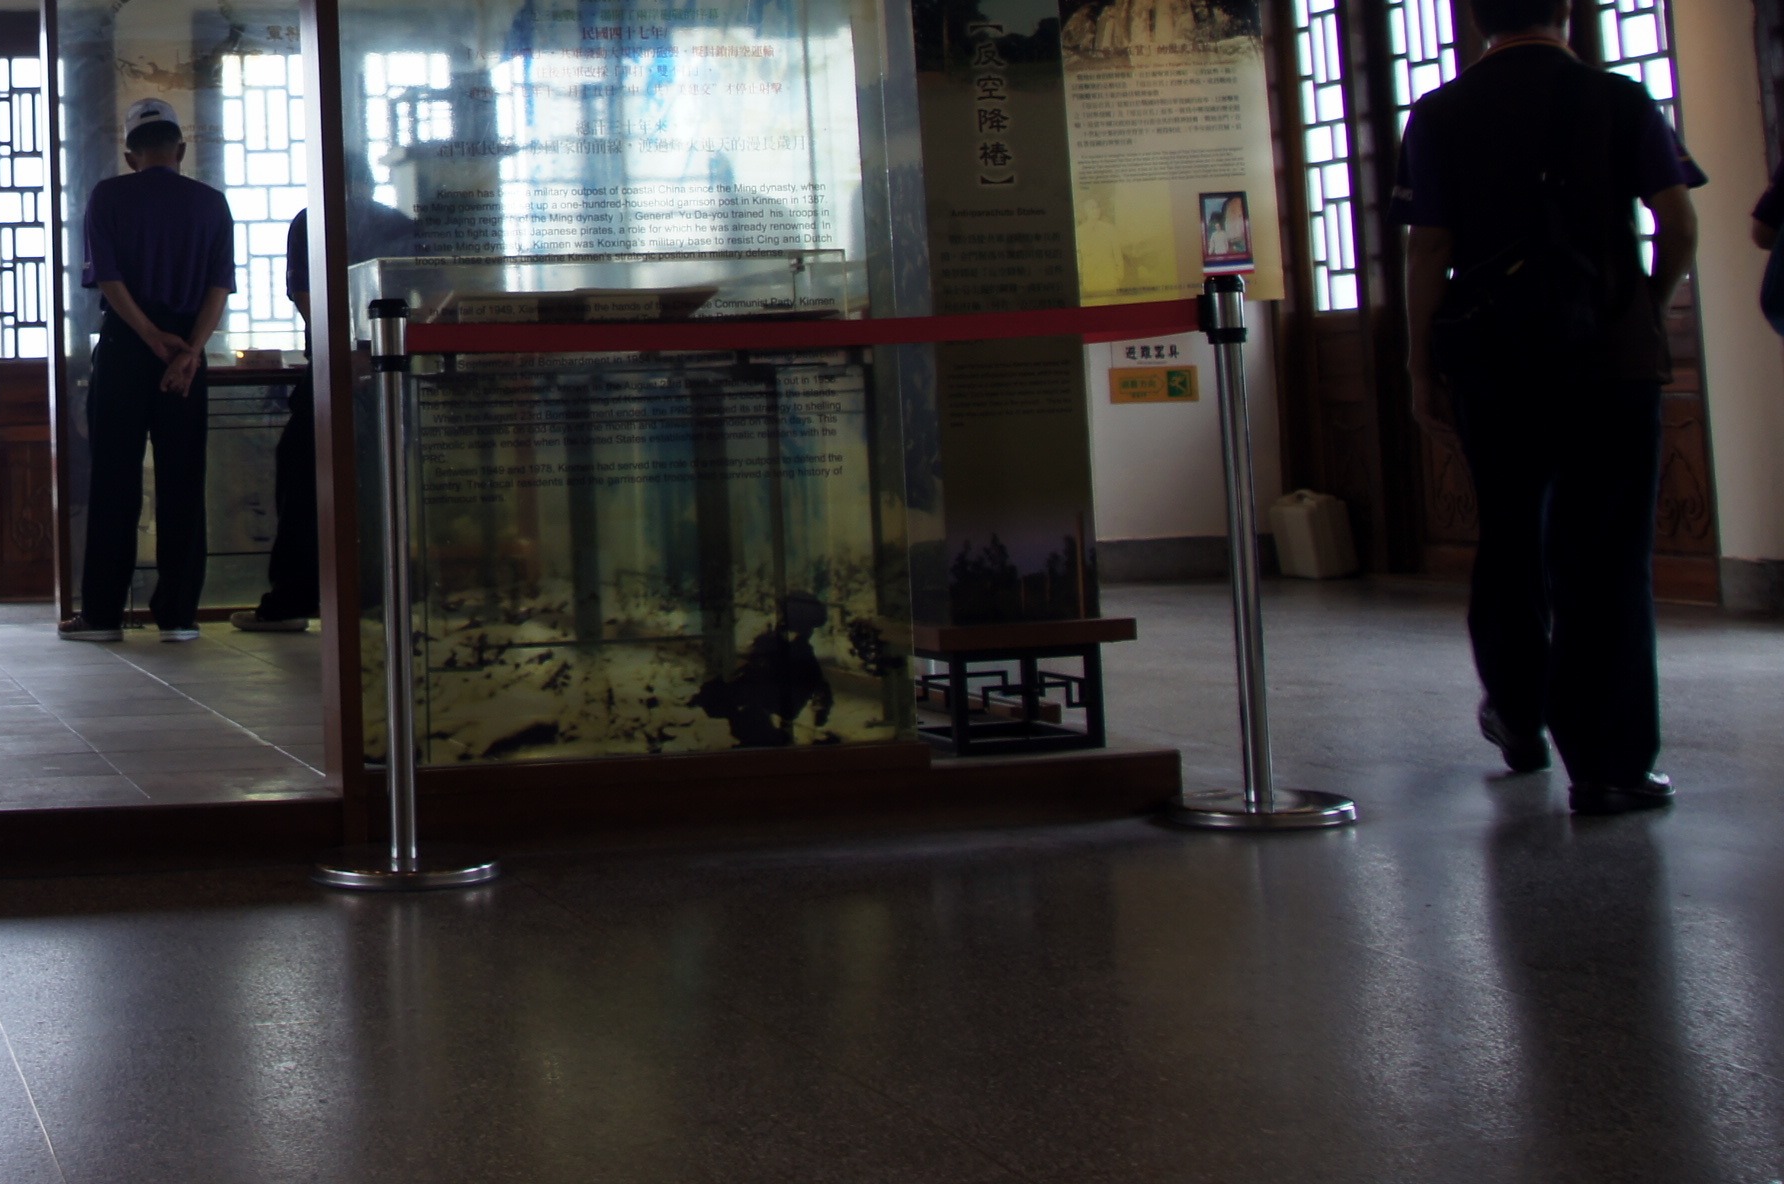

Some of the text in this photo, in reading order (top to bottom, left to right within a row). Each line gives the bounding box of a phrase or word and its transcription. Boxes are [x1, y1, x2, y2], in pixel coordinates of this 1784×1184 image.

[436, 181, 827, 199] Kinmen has military outpost of coastal China since the Ming dynasty, when
[431, 195, 799, 214] Ming up one-hundred-household garrison post in Kinmen in
[530, 208, 830, 224] the Ming dynasty General trained his troops in
[416, 221, 831, 240] Kinmen to fight Japanese pirates, role for which he was already renowned. In
[433, 233, 833, 254] late Ming Kinmen was Koxinga's military base to resist and Dutch
[698, 250, 707, 259] in
[477, 305, 487, 315] of
[489, 304, 515, 316] 1949,
[594, 302, 611, 313] the
[612, 301, 642, 312] hands
[644, 300, 654, 311] of
[715, 297, 768, 309] Communist
[799, 296, 836, 306] Kinmen
[538, 356, 623, 368] Bombardment in
[483, 412, 518, 425] August
[520, 410, 542, 422] 23rd
[615, 407, 647, 417] ended,
[652, 406, 667, 416] the
[670, 406, 694, 415] PRC
[793, 403, 803, 411] to
[805, 401, 842, 413] shelling
[818, 415, 838, 425] This
[423, 428, 837, 453] symbolic ended when States with the
[435, 453, 844, 478] Between and had served the role defend the
[466, 467, 844, 491] The residents history of
